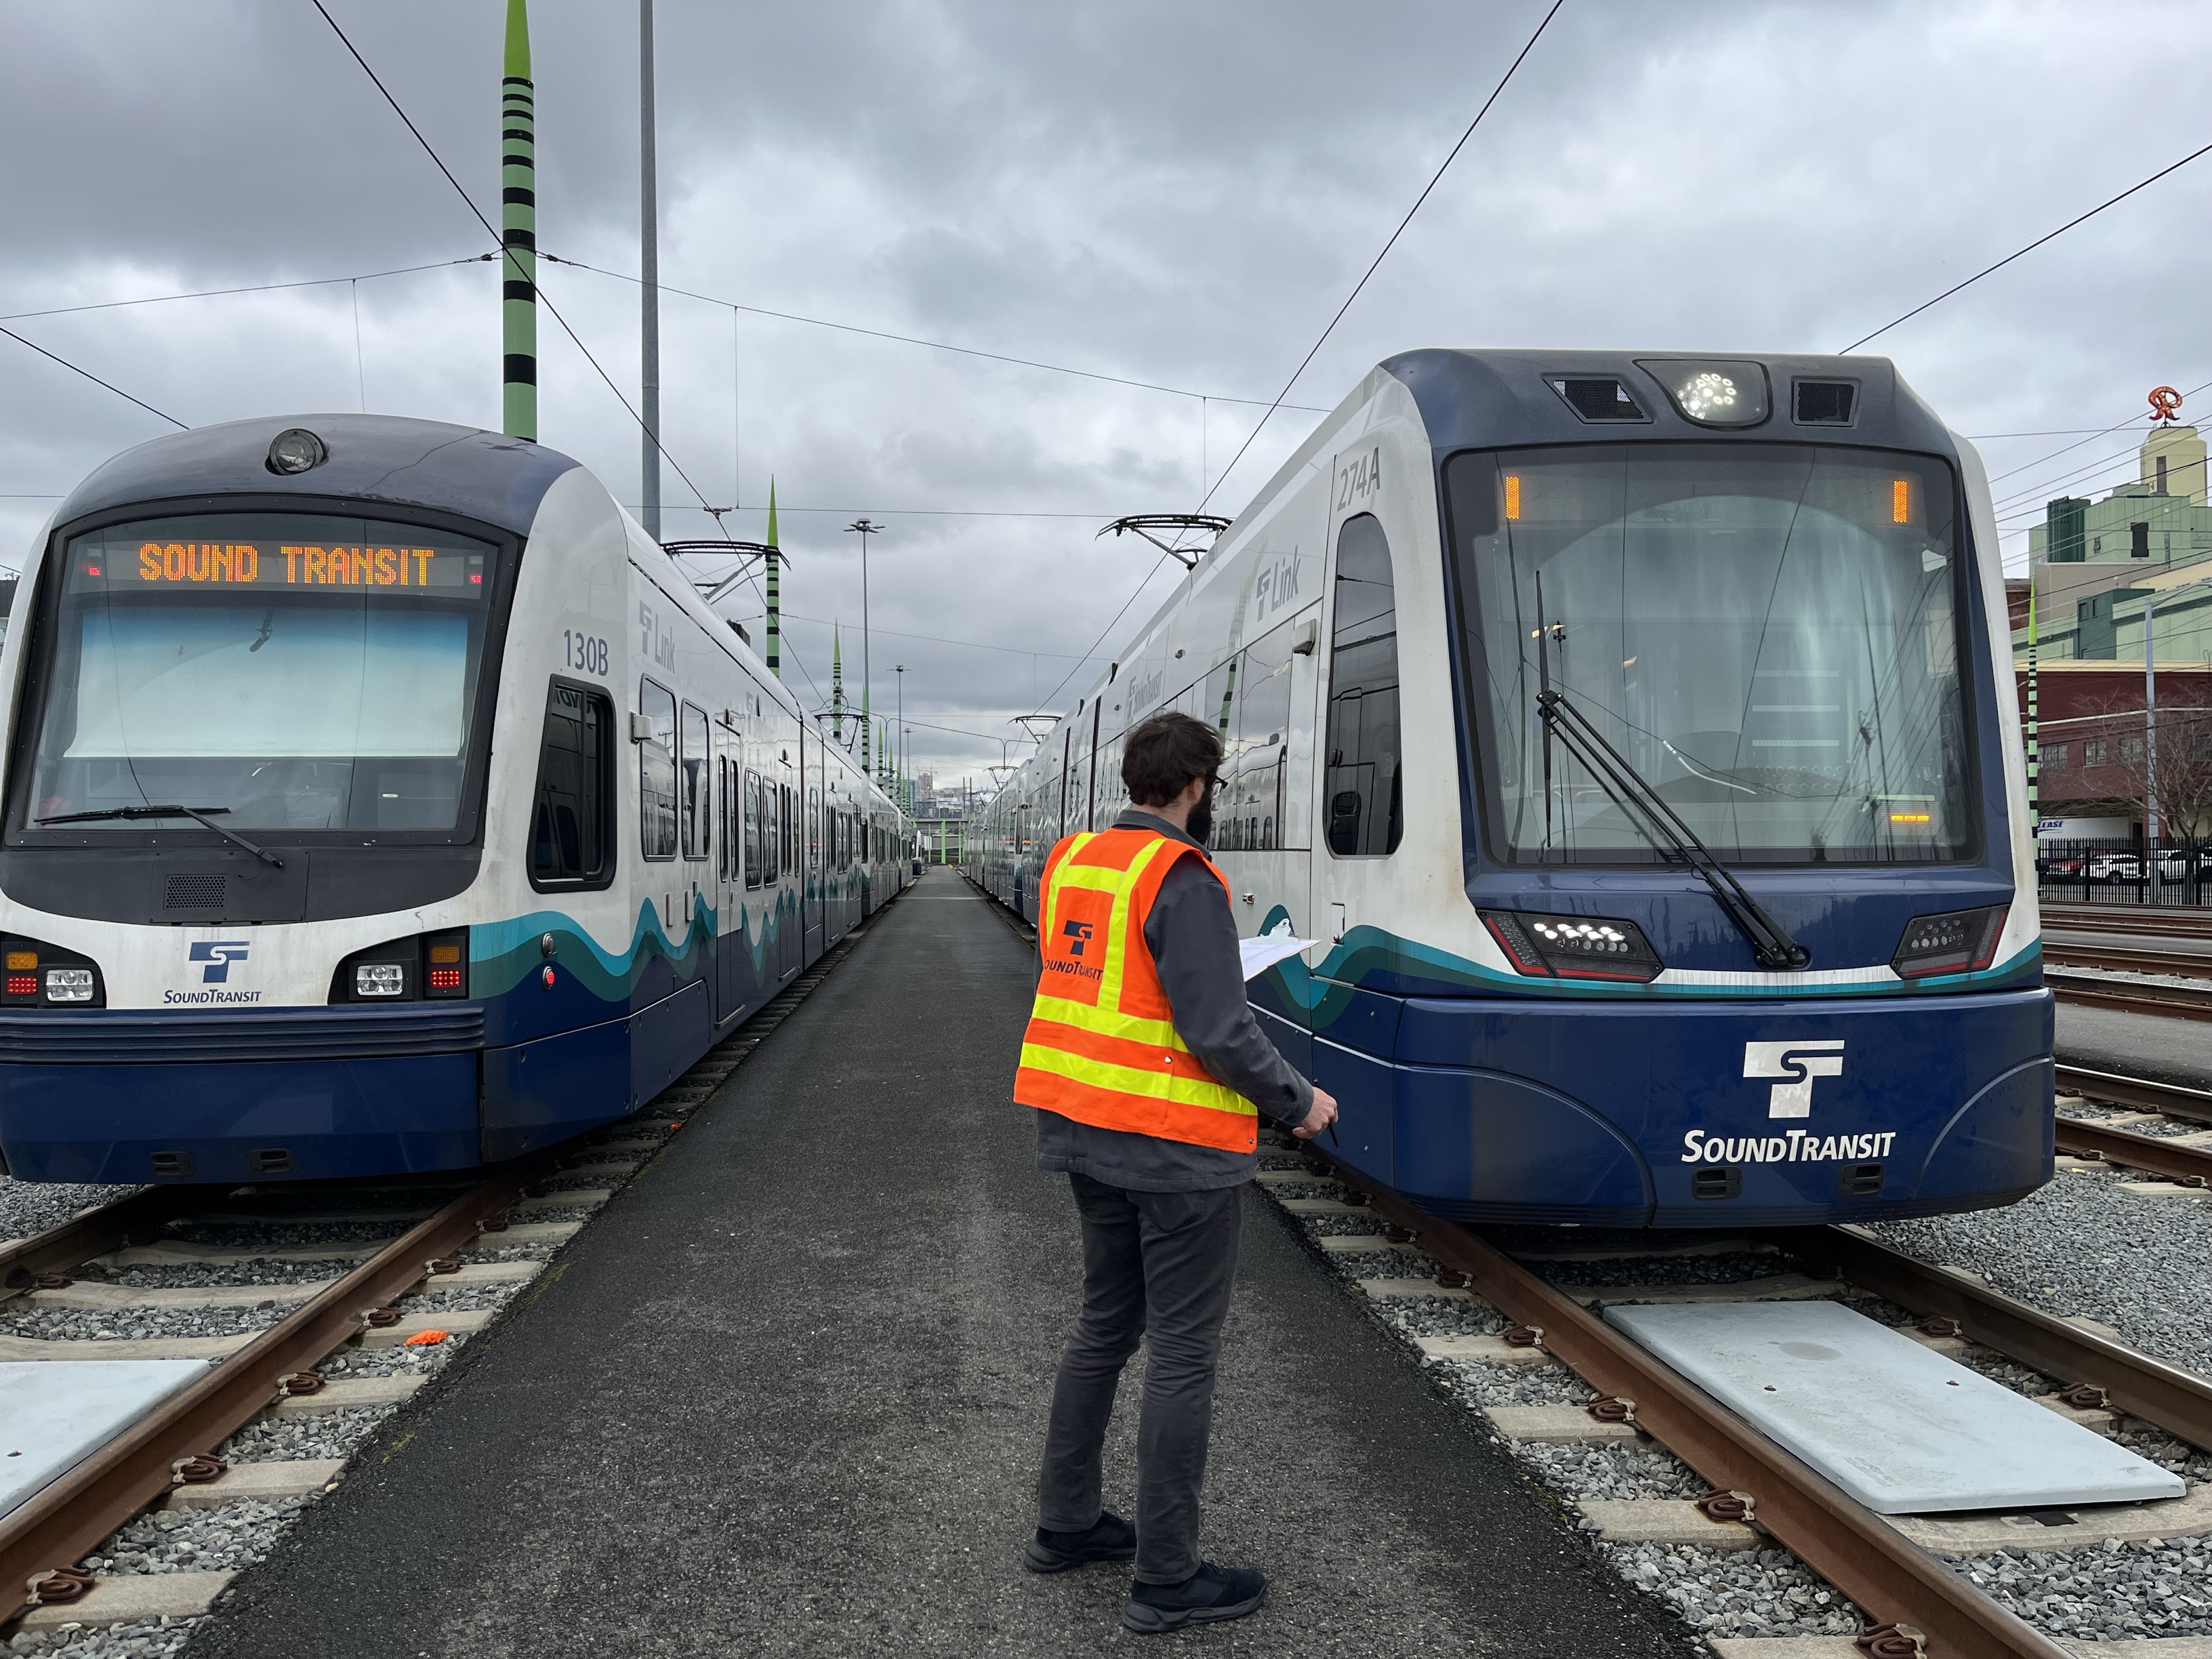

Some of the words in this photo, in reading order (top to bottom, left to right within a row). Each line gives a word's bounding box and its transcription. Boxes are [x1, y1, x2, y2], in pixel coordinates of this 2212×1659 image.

[1337, 446, 1380, 512] 274A
[139, 543, 258, 582] SOUND
[280, 546, 434, 586] TRANSIT
[1271, 544, 1301, 613] Link
[564, 629, 609, 676] 130B
[655, 613, 676, 674] Link
[1044, 959, 1104, 981] OUNDTRANSIT
[163, 989, 262, 1004] SOUNDTRANSIT
[1681, 1129, 1896, 1163] SOUNDTRANSIT
